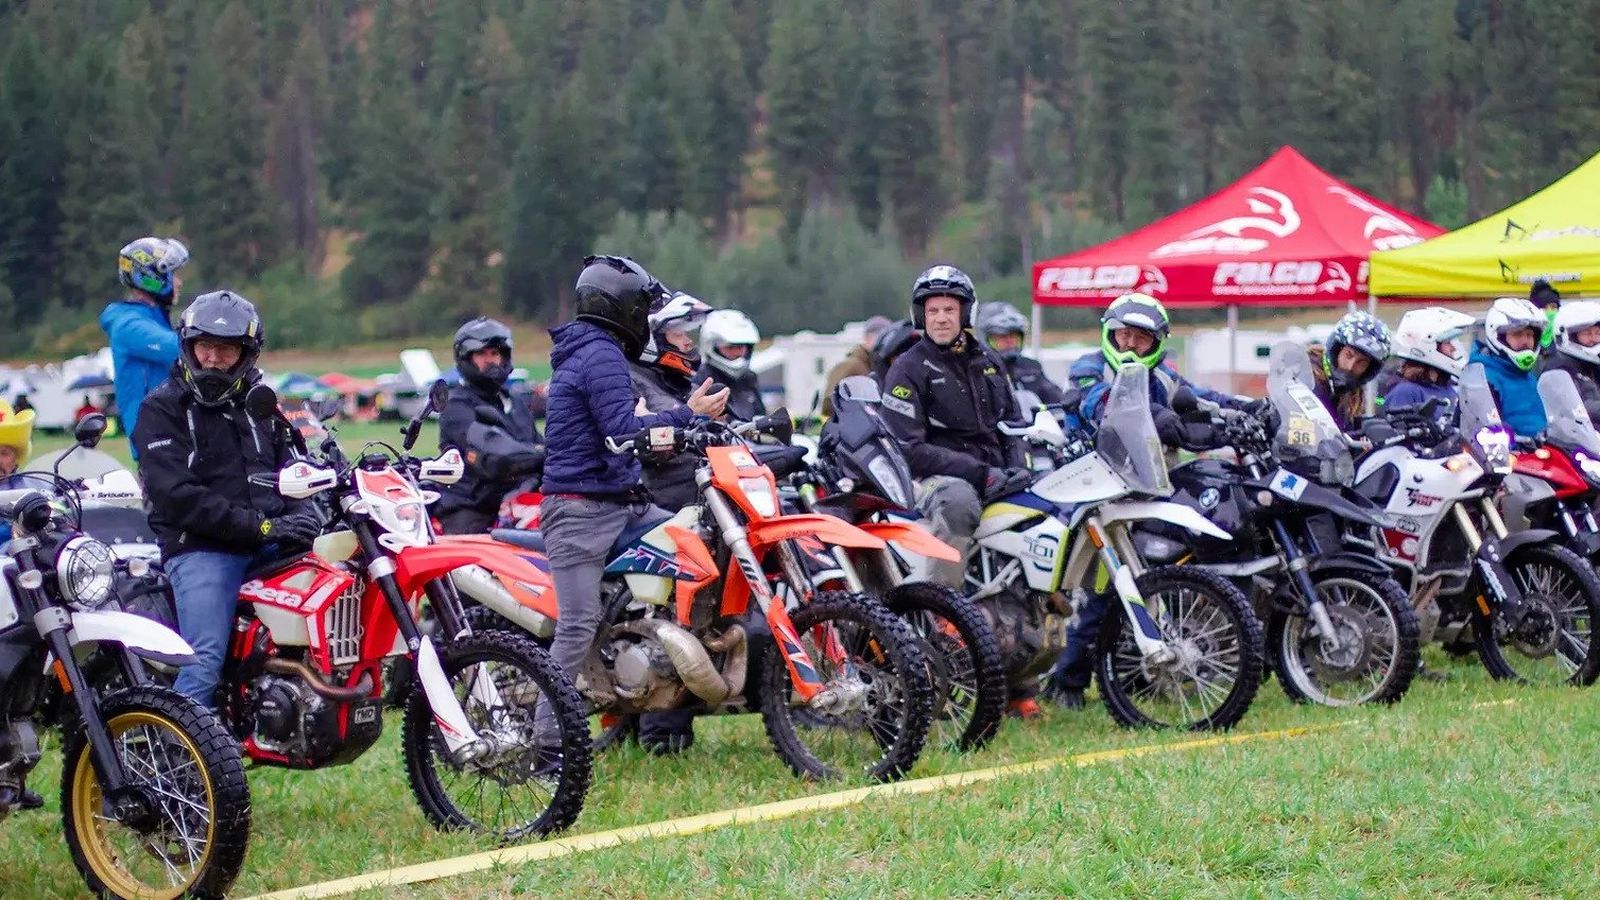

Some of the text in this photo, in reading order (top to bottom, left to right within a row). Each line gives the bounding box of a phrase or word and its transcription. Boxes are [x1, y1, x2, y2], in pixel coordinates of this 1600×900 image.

[1038, 265, 1141, 292] FALCO
[1212, 261, 1323, 286] FALCO
[1293, 430, 1310, 444] 36
[240, 579, 302, 609] Beta
